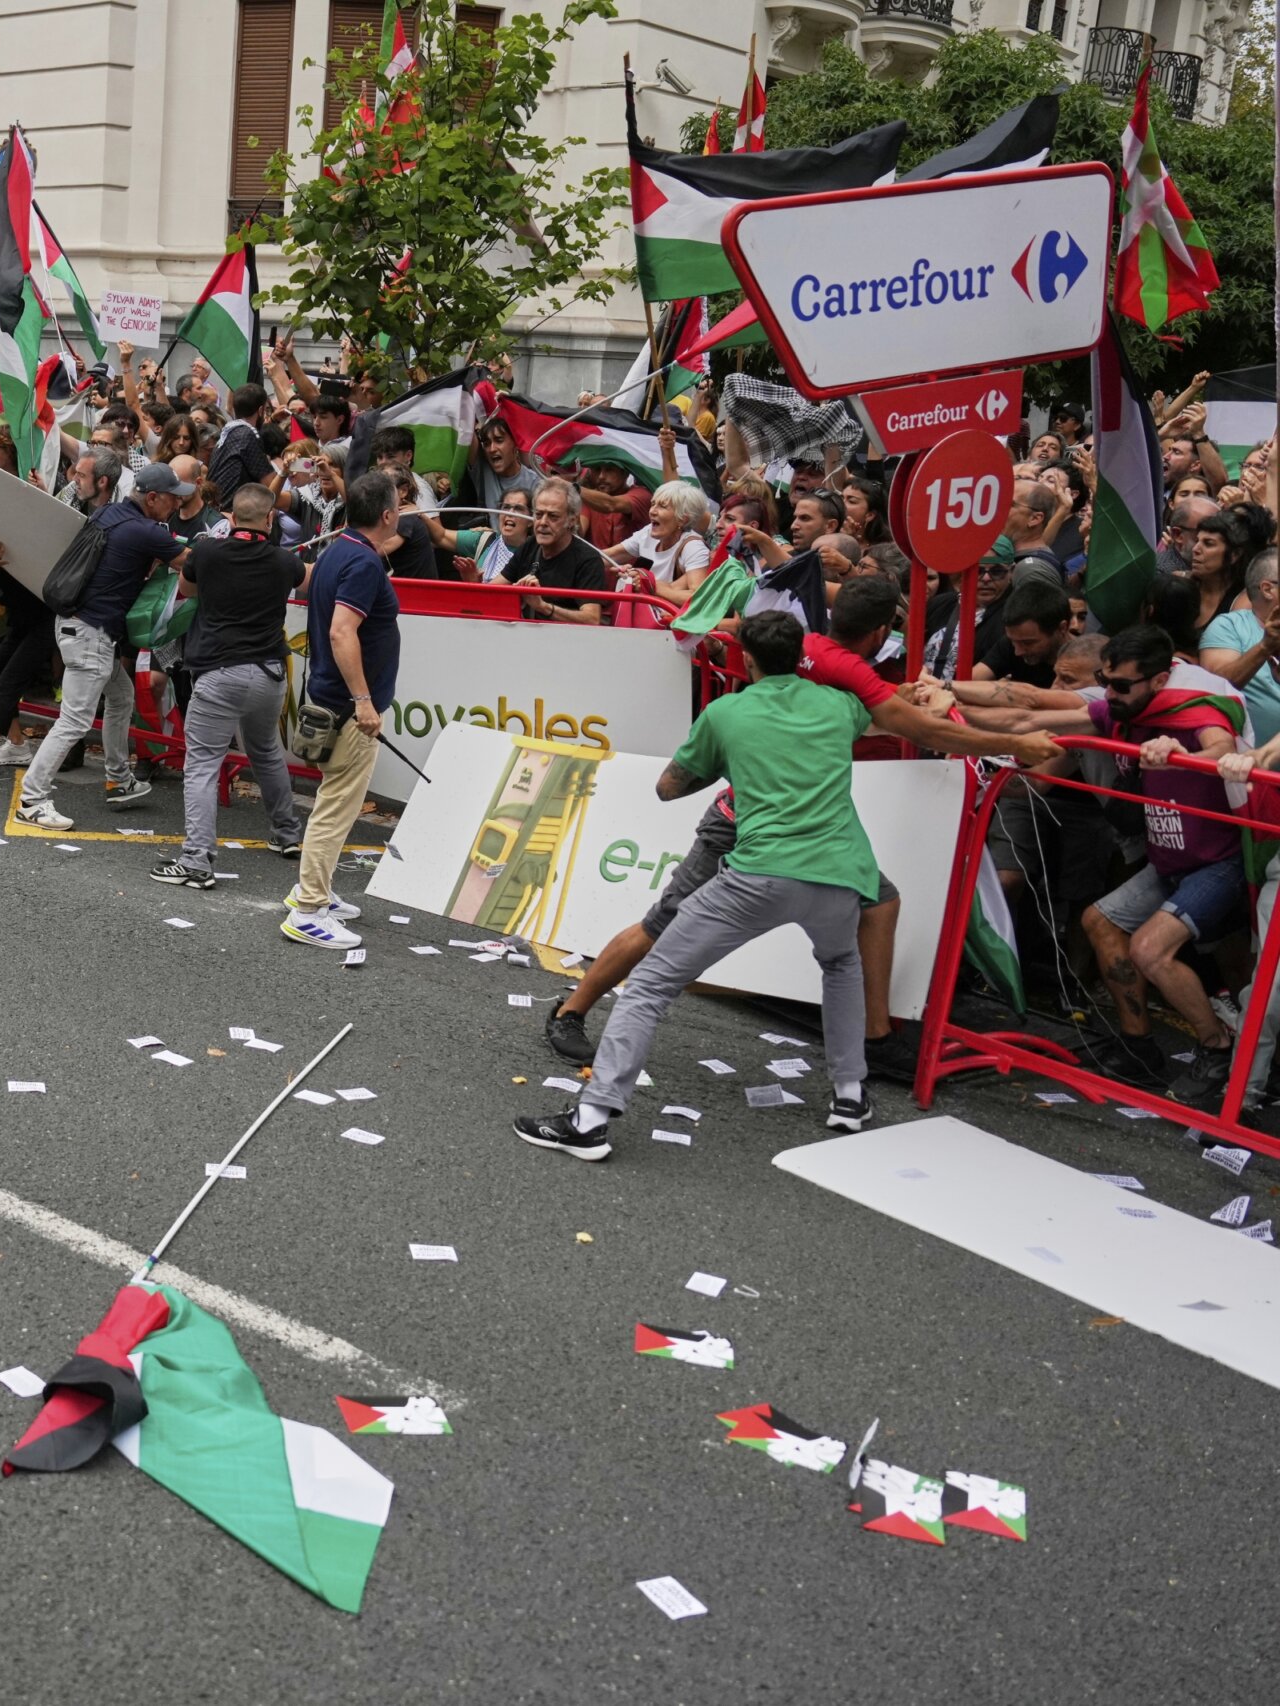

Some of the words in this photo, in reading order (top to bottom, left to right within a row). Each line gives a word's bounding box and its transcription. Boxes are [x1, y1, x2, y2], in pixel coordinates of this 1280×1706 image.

[106, 292, 135, 305] SYLVAN
[791, 258, 995, 322] Carrefour
[101, 304, 109, 312] DO
[112, 306, 126, 315] NOT
[130, 307, 151, 318] WASH
[106, 315, 116, 326] THE
[120, 316, 158, 332] GENOCIDE
[886, 403, 969, 433] Carrefour
[925, 474, 1000, 531] 150
